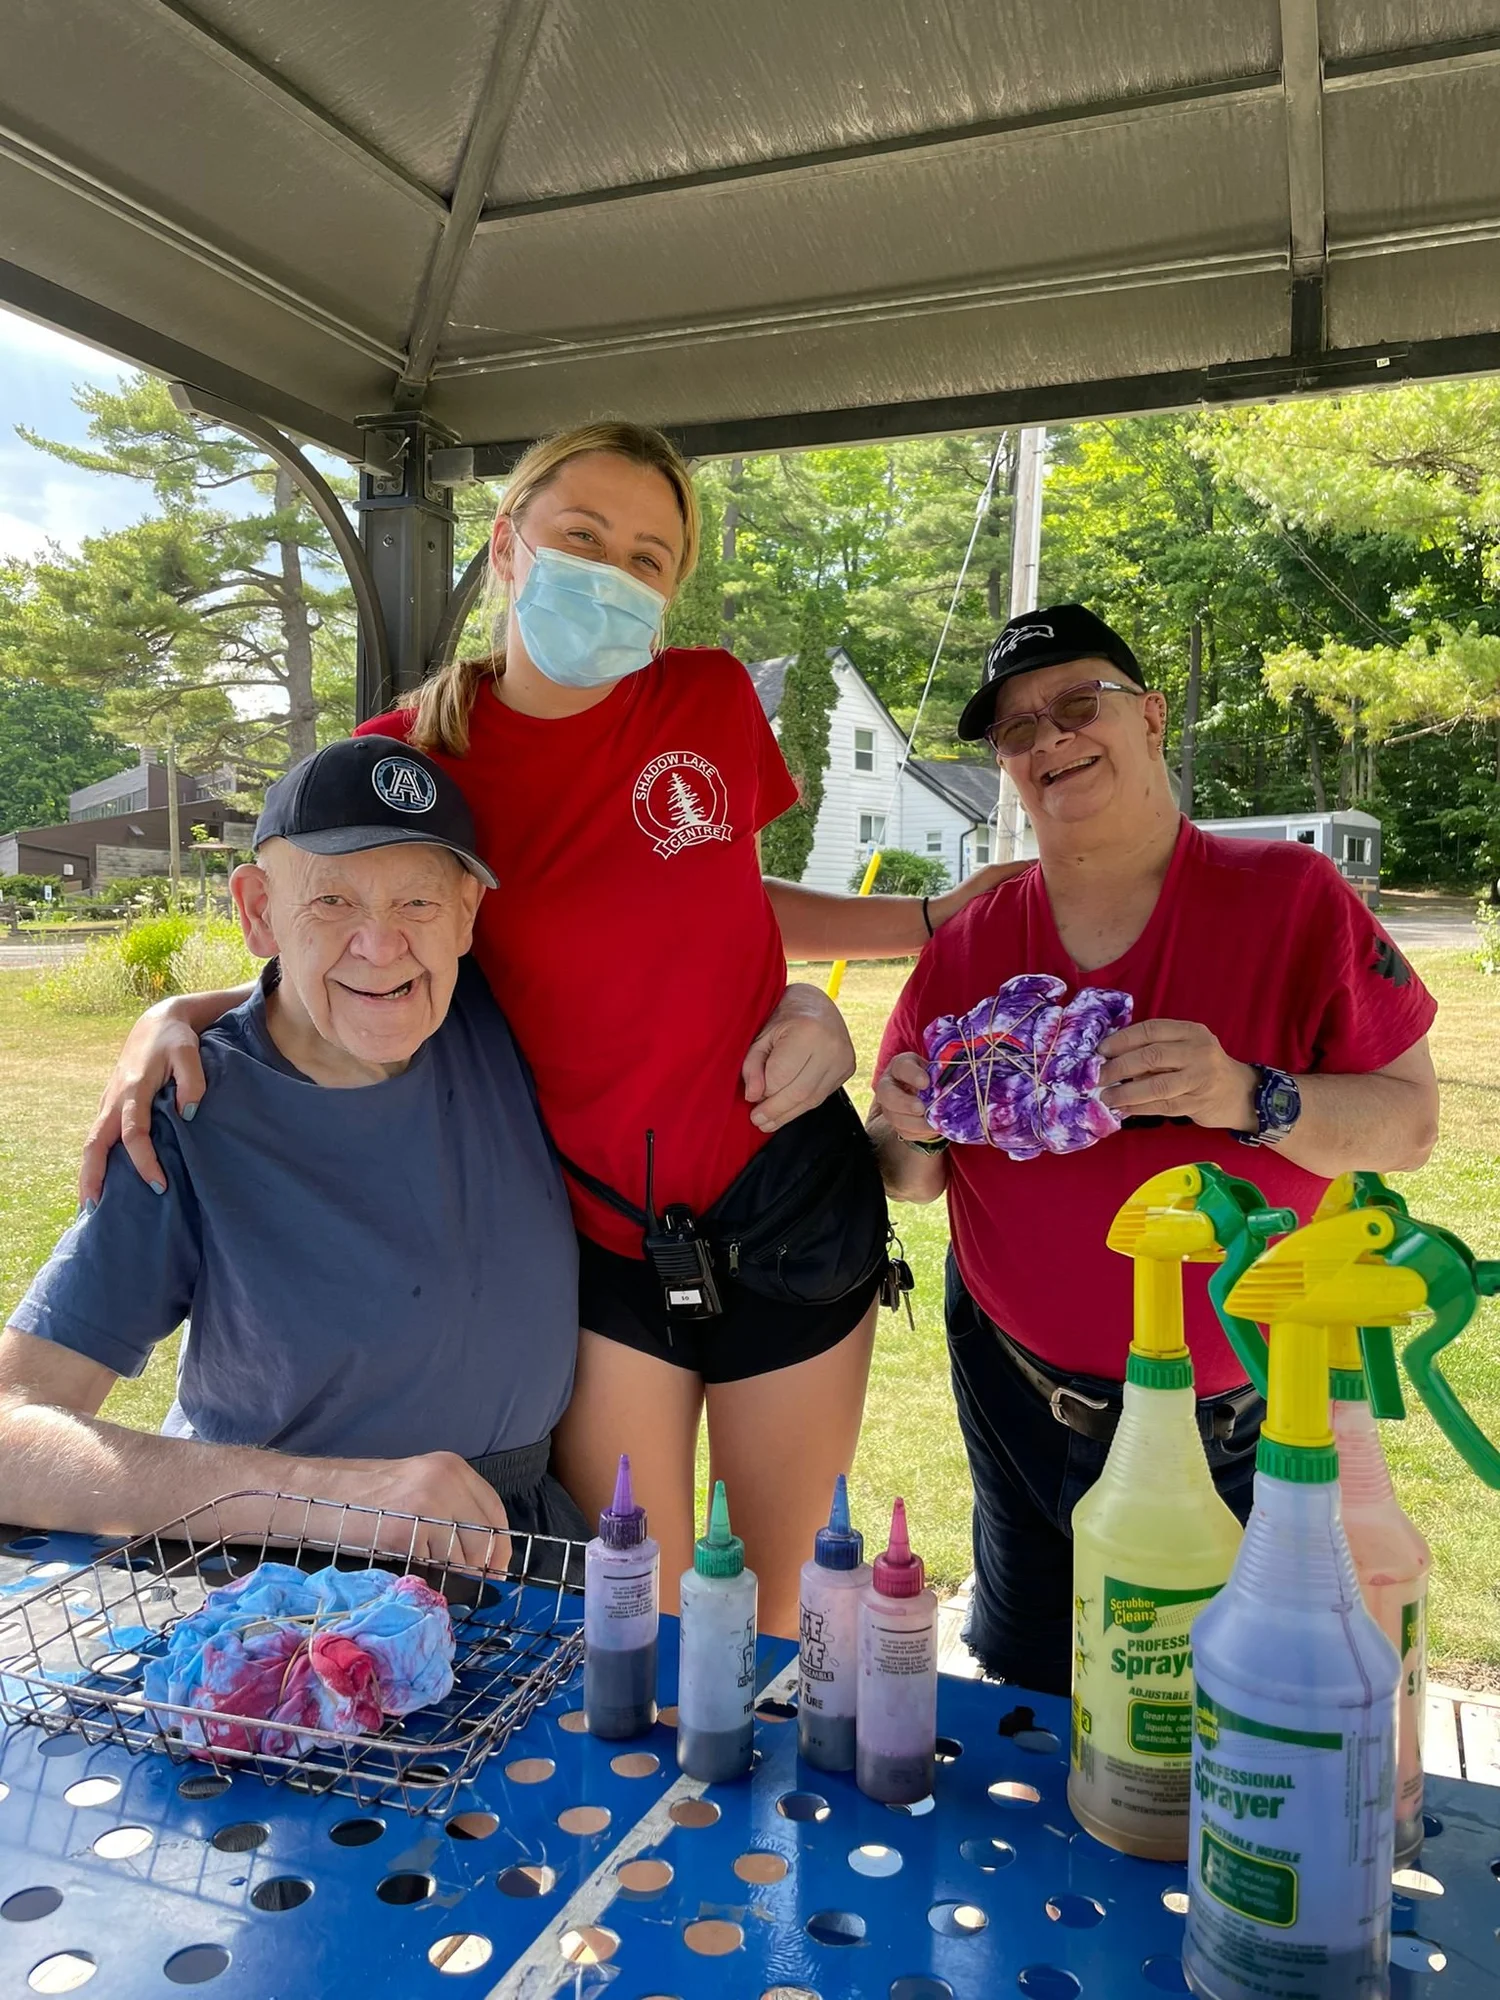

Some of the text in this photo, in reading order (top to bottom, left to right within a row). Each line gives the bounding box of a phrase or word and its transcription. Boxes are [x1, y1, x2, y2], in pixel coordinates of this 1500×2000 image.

[386, 764, 428, 807] A
[636, 754, 715, 800] SHADOW LAKE
[670, 826, 721, 848] CENTRE
[1110, 1597, 1155, 1611] Scrubber
[1114, 1609, 1155, 1624] Cleanz
[1128, 1634, 1190, 1651] PROFESSI
[1111, 1648, 1193, 1680] Spray
[1129, 1687, 1189, 1699] ADJUSTABLE
[1201, 1755, 1295, 1789] PROFESSIONAL
[1194, 1761, 1285, 1819] Sprayer
[1256, 1844, 1301, 1863] NOZZLE
